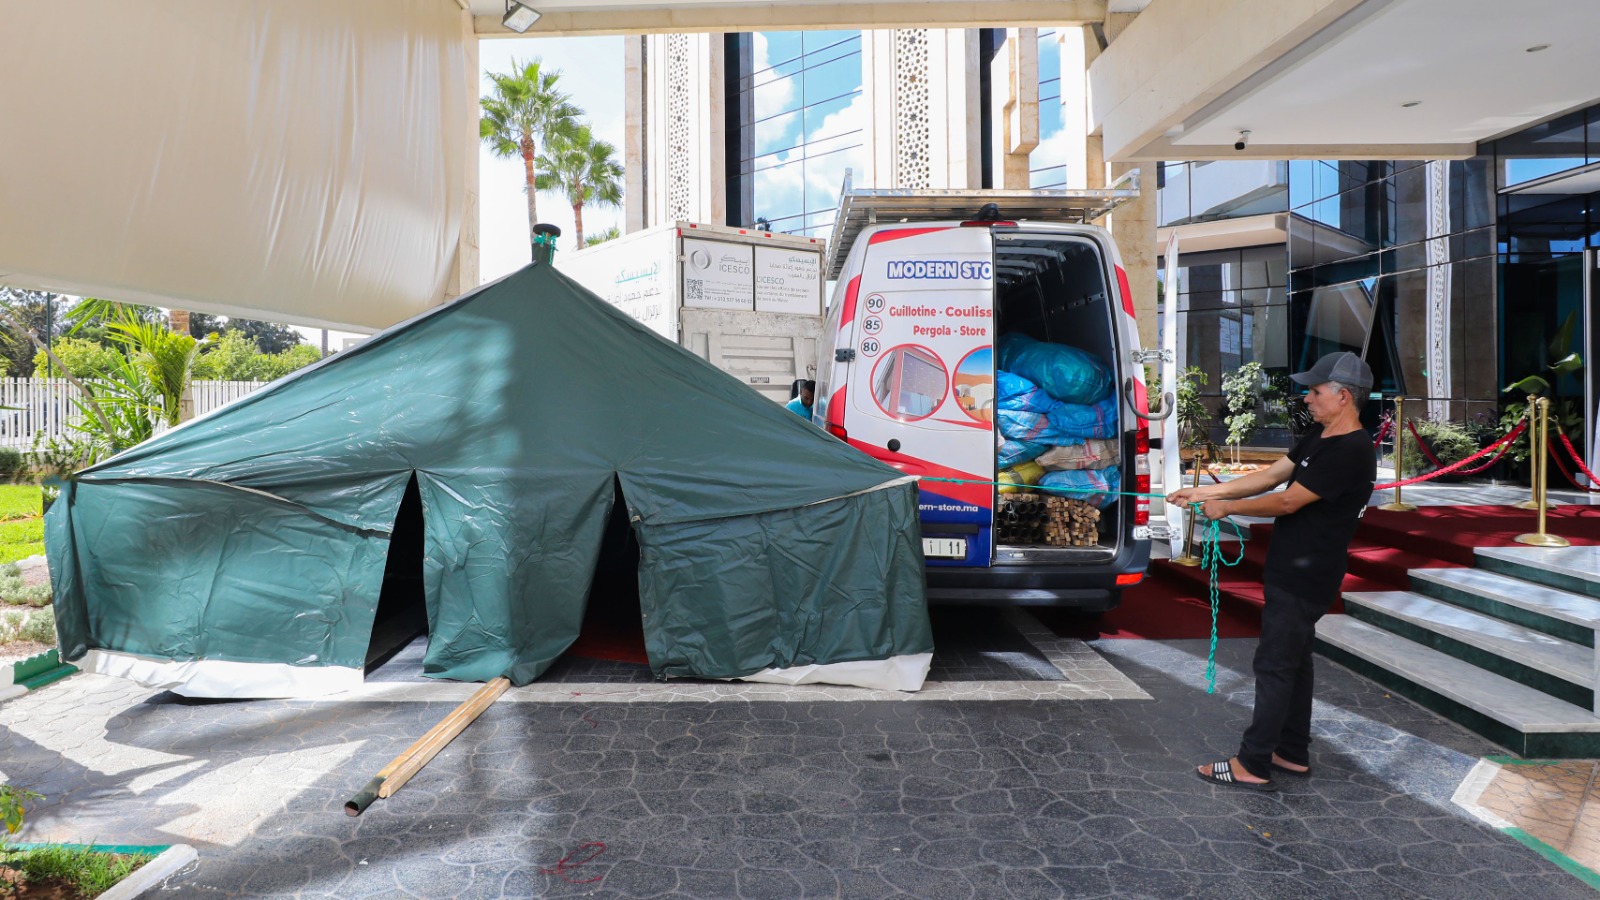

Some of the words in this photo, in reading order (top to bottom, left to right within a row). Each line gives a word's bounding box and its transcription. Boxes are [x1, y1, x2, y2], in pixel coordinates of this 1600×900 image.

[719, 264, 750, 275] ICESCO
[887, 261, 958, 279] MODERN
[868, 298, 883, 309] 90
[889, 305, 936, 318] Guillotine
[945, 305, 992, 318] Couliss
[865, 320, 881, 331] 85
[913, 325, 951, 338] Pergola
[960, 325, 986, 336] Store
[863, 342, 878, 352] 80
[949, 541, 960, 555] 11
